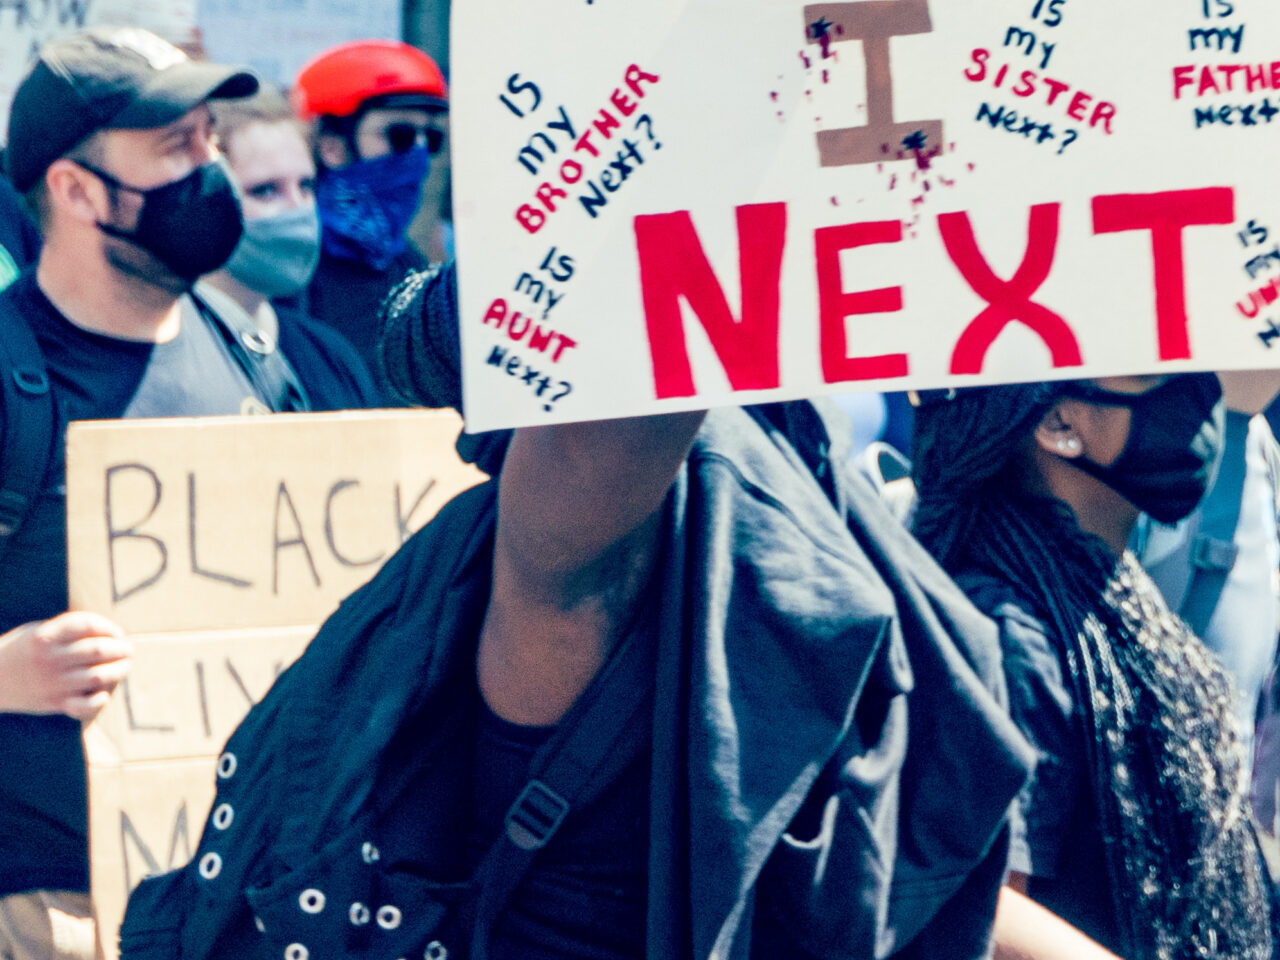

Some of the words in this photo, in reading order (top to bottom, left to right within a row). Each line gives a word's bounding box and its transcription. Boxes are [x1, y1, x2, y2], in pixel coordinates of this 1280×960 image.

[499, 73, 543, 119] IS
[963, 47, 1117, 136] SISTER
[515, 63, 661, 235] BROTHER
[538, 246, 577, 283] IS
[1237, 219, 1269, 249] IS
[633, 186, 1236, 400] NEXT
[482, 297, 579, 365] AUNT
